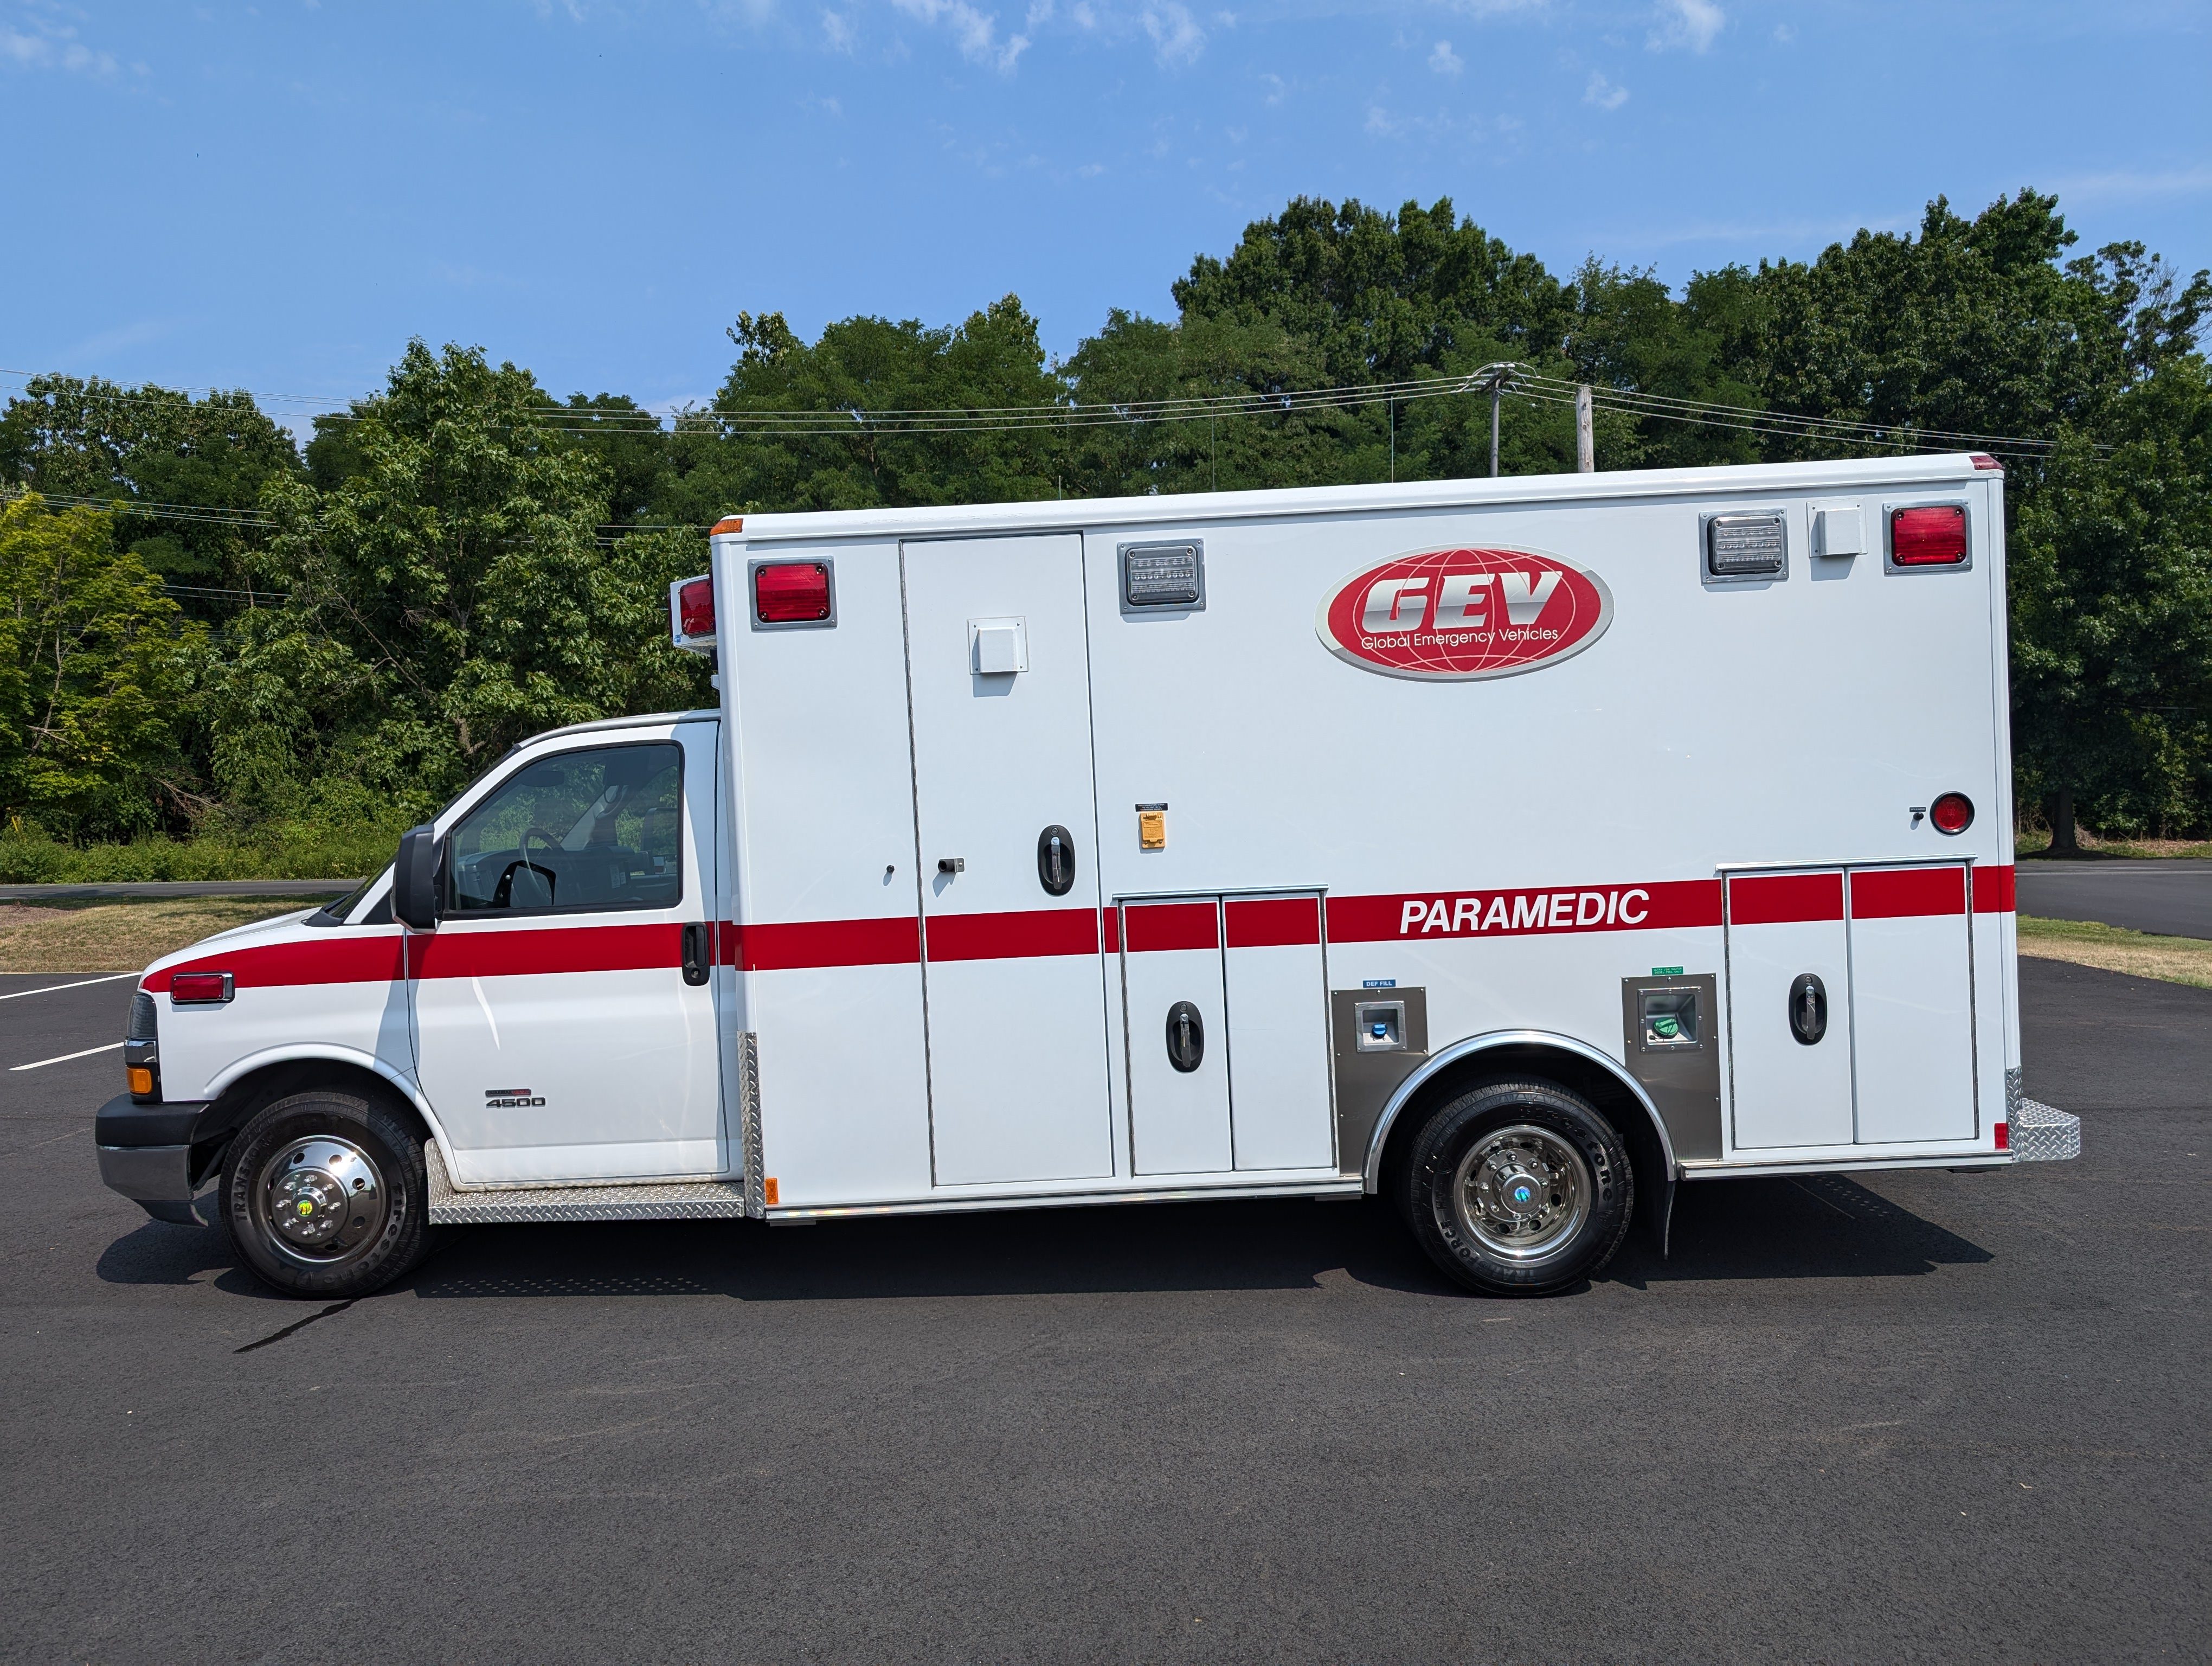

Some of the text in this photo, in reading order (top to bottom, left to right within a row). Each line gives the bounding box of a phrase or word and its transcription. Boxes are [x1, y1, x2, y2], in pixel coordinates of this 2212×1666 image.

[1361, 571, 1563, 633] GEV
[1361, 628, 1559, 650] Global Emergency Vehicles
[1399, 889, 1650, 934] PARAMEDIC
[486, 1097, 545, 1107] 4500
